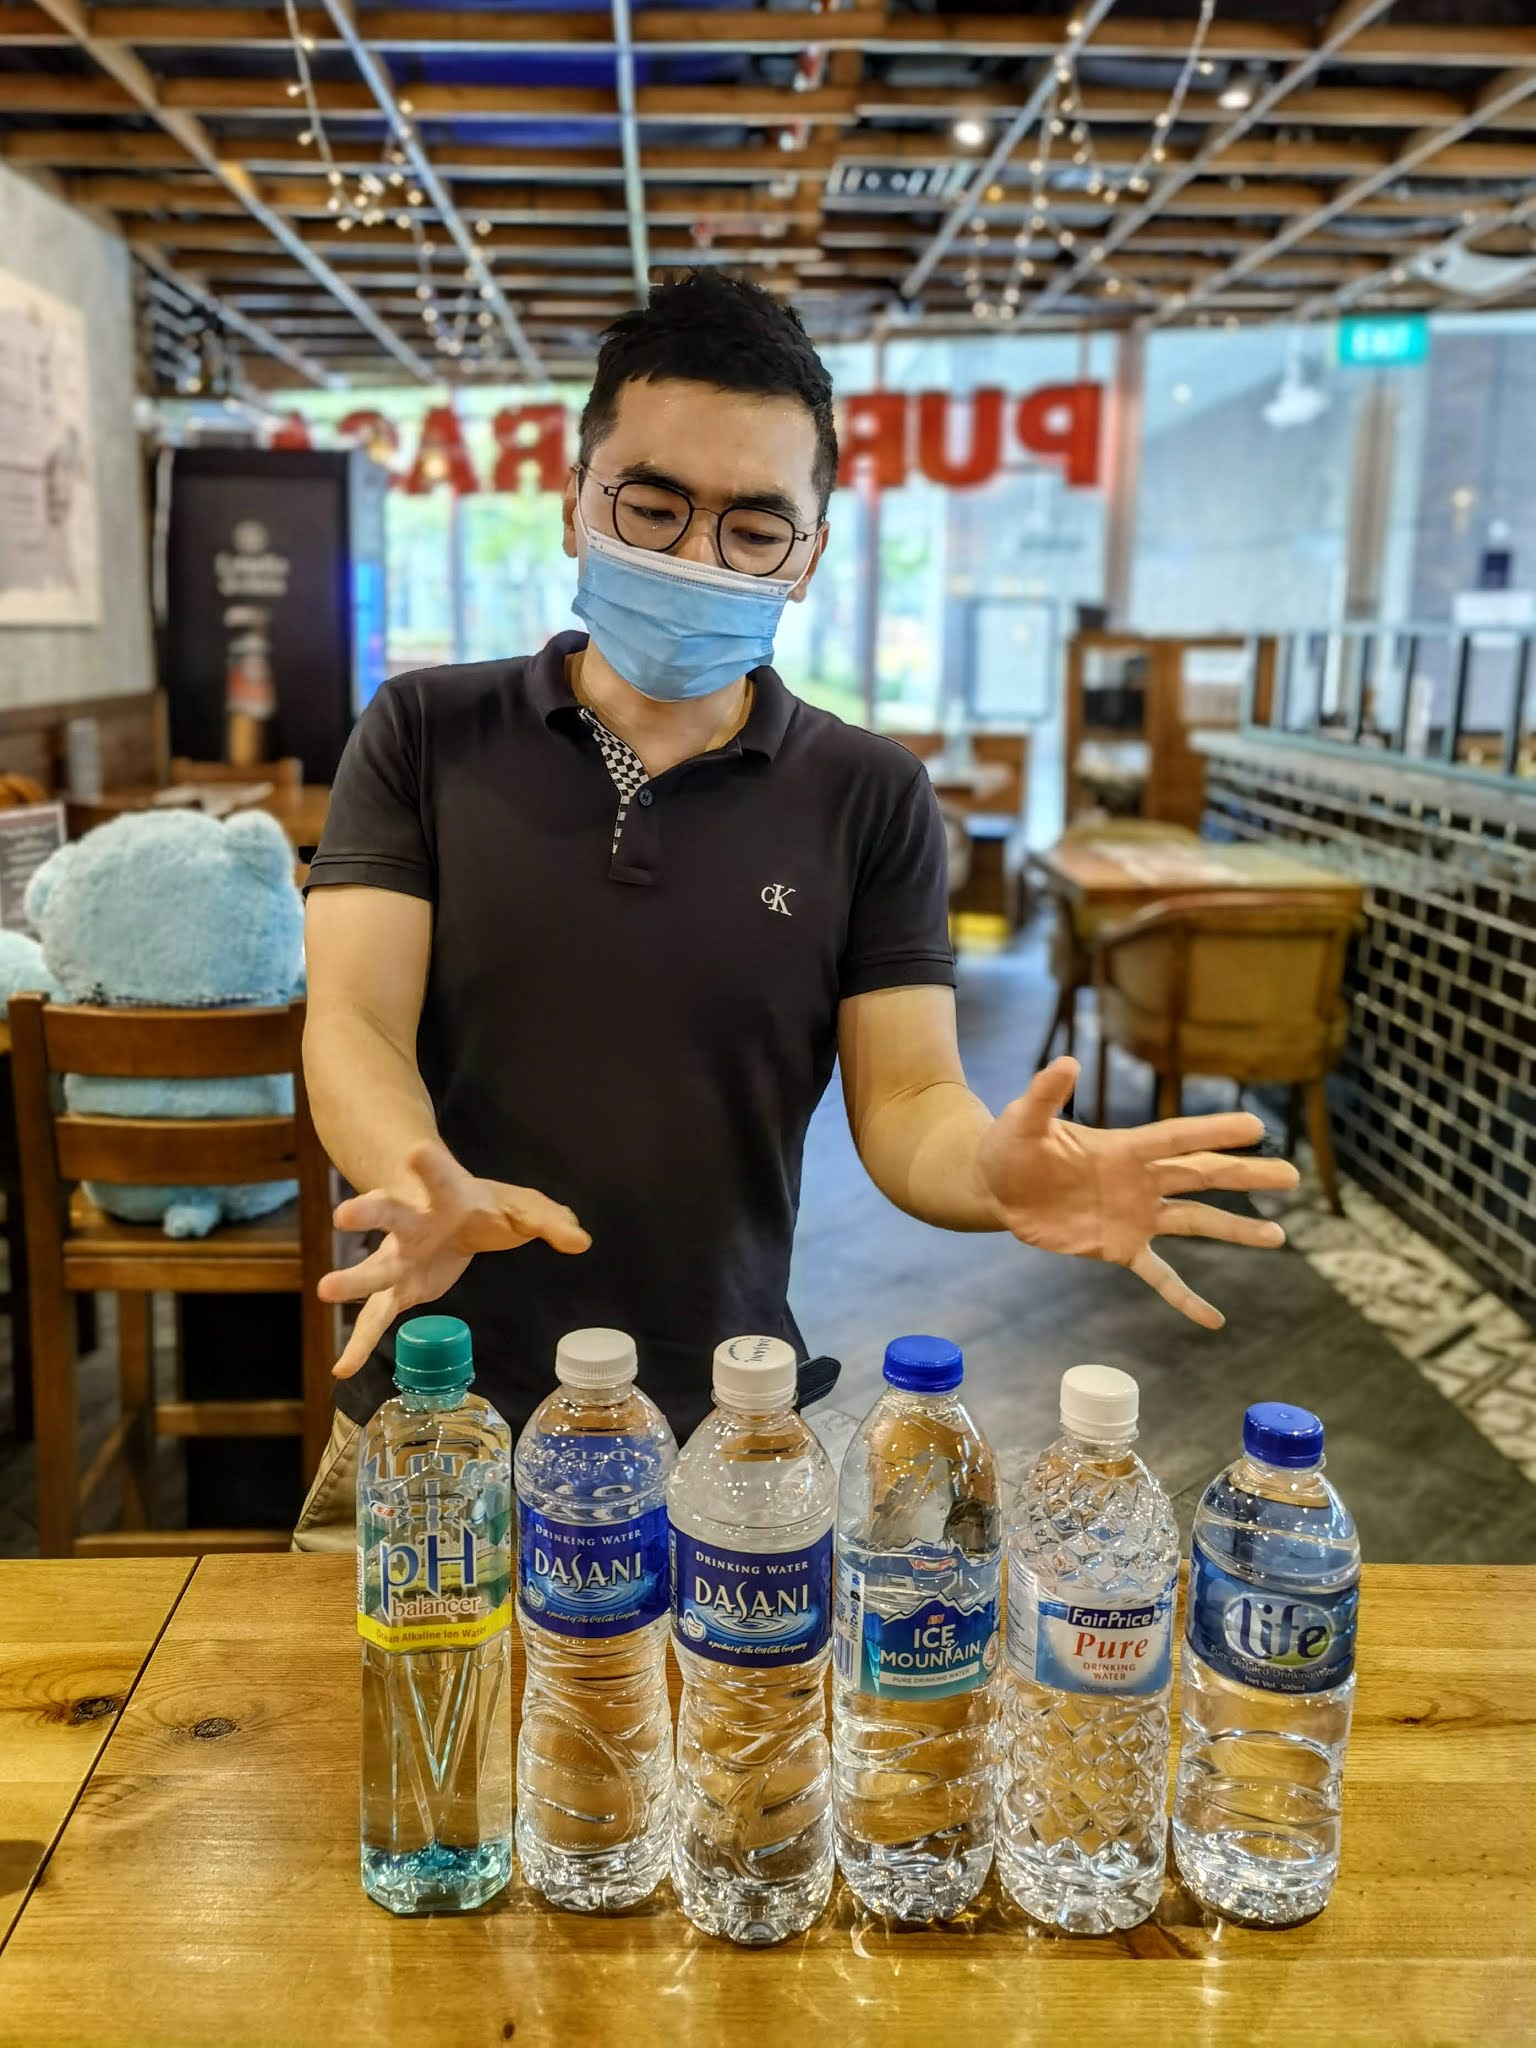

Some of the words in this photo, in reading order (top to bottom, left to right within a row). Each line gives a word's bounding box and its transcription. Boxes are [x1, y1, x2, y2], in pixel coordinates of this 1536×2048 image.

[535, 1523, 596, 1546] DRINKING
[601, 1529, 642, 1546] WATER
[379, 1519, 477, 1622] pH
[534, 1547, 643, 1594] DASANI
[695, 1550, 760, 1575] DRINKING
[766, 1560, 809, 1575] WATER
[390, 1596, 482, 1618] balancer
[694, 1575, 809, 1624] DASANI
[1071, 1608, 1151, 1628] FairPrice
[401, 1629, 441, 1643] Alkaline
[443, 1628, 460, 1640] Ion
[461, 1625, 488, 1639] Water
[913, 1623, 956, 1649] ICE
[1072, 1631, 1149, 1660] Pure
[880, 1640, 981, 1669] MOUNTAIN
[1083, 1661, 1136, 1672] DRINKING
[1210, 1644, 1229, 1662] Pure
[1231, 1656, 1270, 1676] Distilled
[893, 1675, 912, 1684] PURE
[913, 1673, 947, 1684] DRINKING
[948, 1668, 970, 1680] WATER
[1093, 1672, 1126, 1681] WATER
[1244, 1675, 1260, 1687] Net
